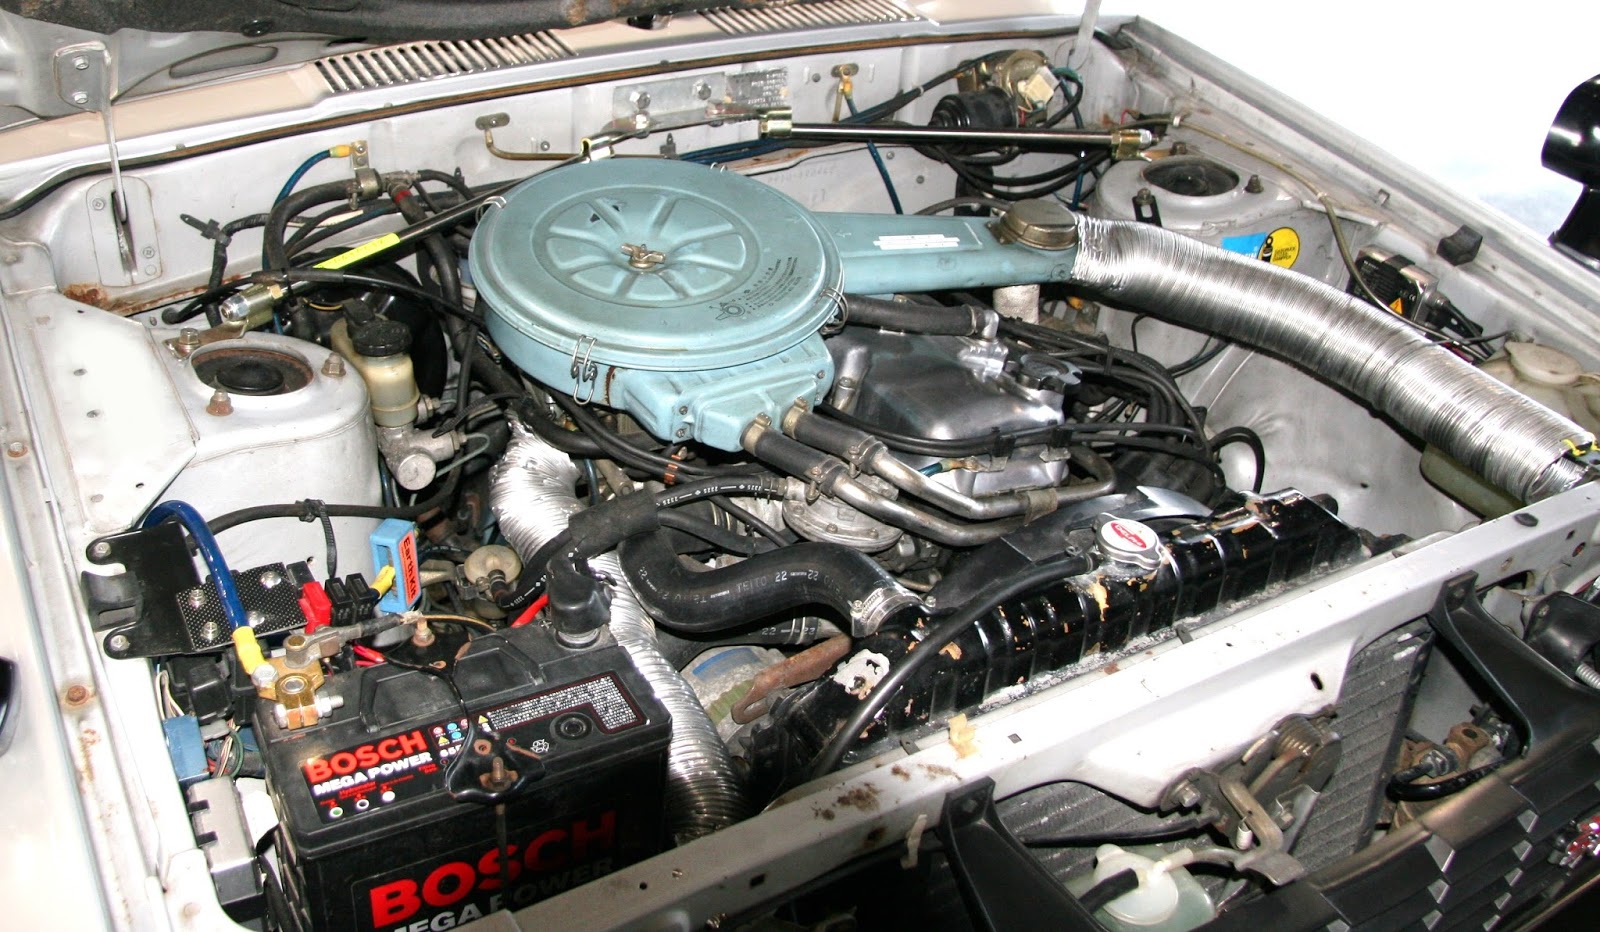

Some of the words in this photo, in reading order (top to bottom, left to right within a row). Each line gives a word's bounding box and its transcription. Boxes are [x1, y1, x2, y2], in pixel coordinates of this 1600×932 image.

[403, 536, 414, 577] Earth
[775, 570, 788, 583] 22
[304, 730, 429, 785] BOSCH
[314, 768, 368, 796] MEGA
[368, 750, 433, 781] POWER
[368, 811, 616, 929] BOSCH
[394, 902, 484, 932] EGA
